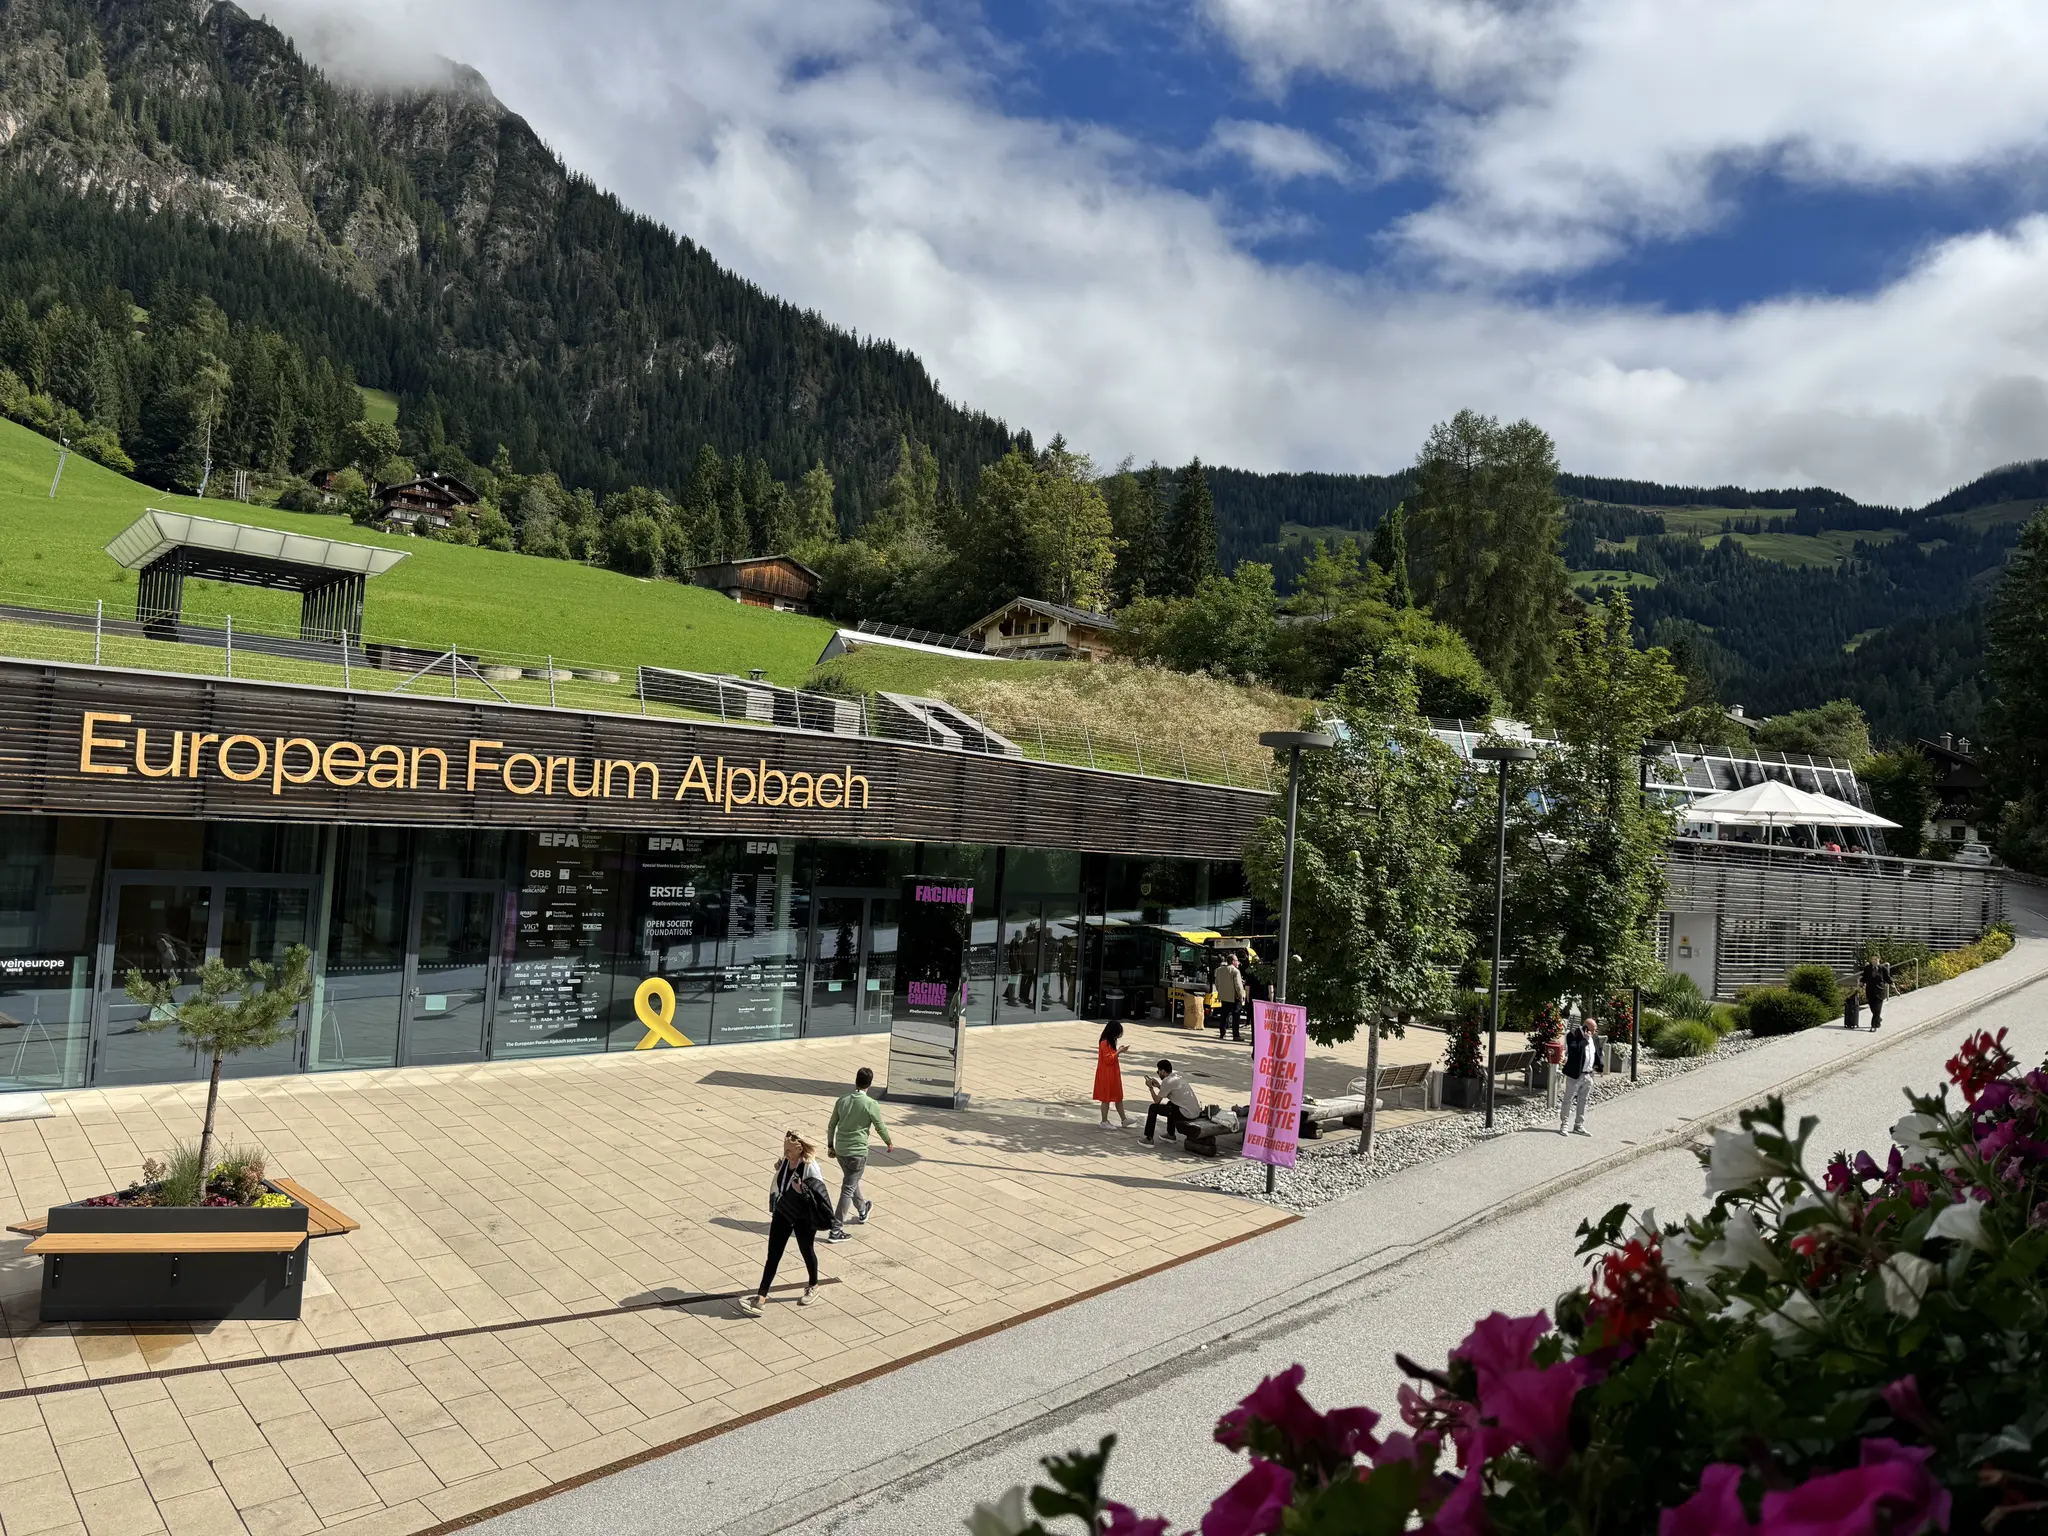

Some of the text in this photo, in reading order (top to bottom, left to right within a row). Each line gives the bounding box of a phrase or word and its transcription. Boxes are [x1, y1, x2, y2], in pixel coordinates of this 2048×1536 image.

[80, 711, 869, 814] European Forum Alpbach
[539, 832, 579, 848] EFA
[648, 837, 684, 852] EFA
[746, 842, 778, 855] EFA
[649, 886, 683, 898] ERSTE
[915, 884, 967, 904] FACING
[646, 920, 694, 928] OPEN SOCIETY
[646, 928, 693, 936] FOUNDATIONS
[908, 981, 947, 995] FACING
[907, 993, 947, 1007] CHANGE
[1277, 1010, 1297, 1023] WEIT
[1274, 1078, 1289, 1091] DIE
[1256, 1086, 1297, 1111] DEMO-
[1252, 1105, 1296, 1130] KRATIE
